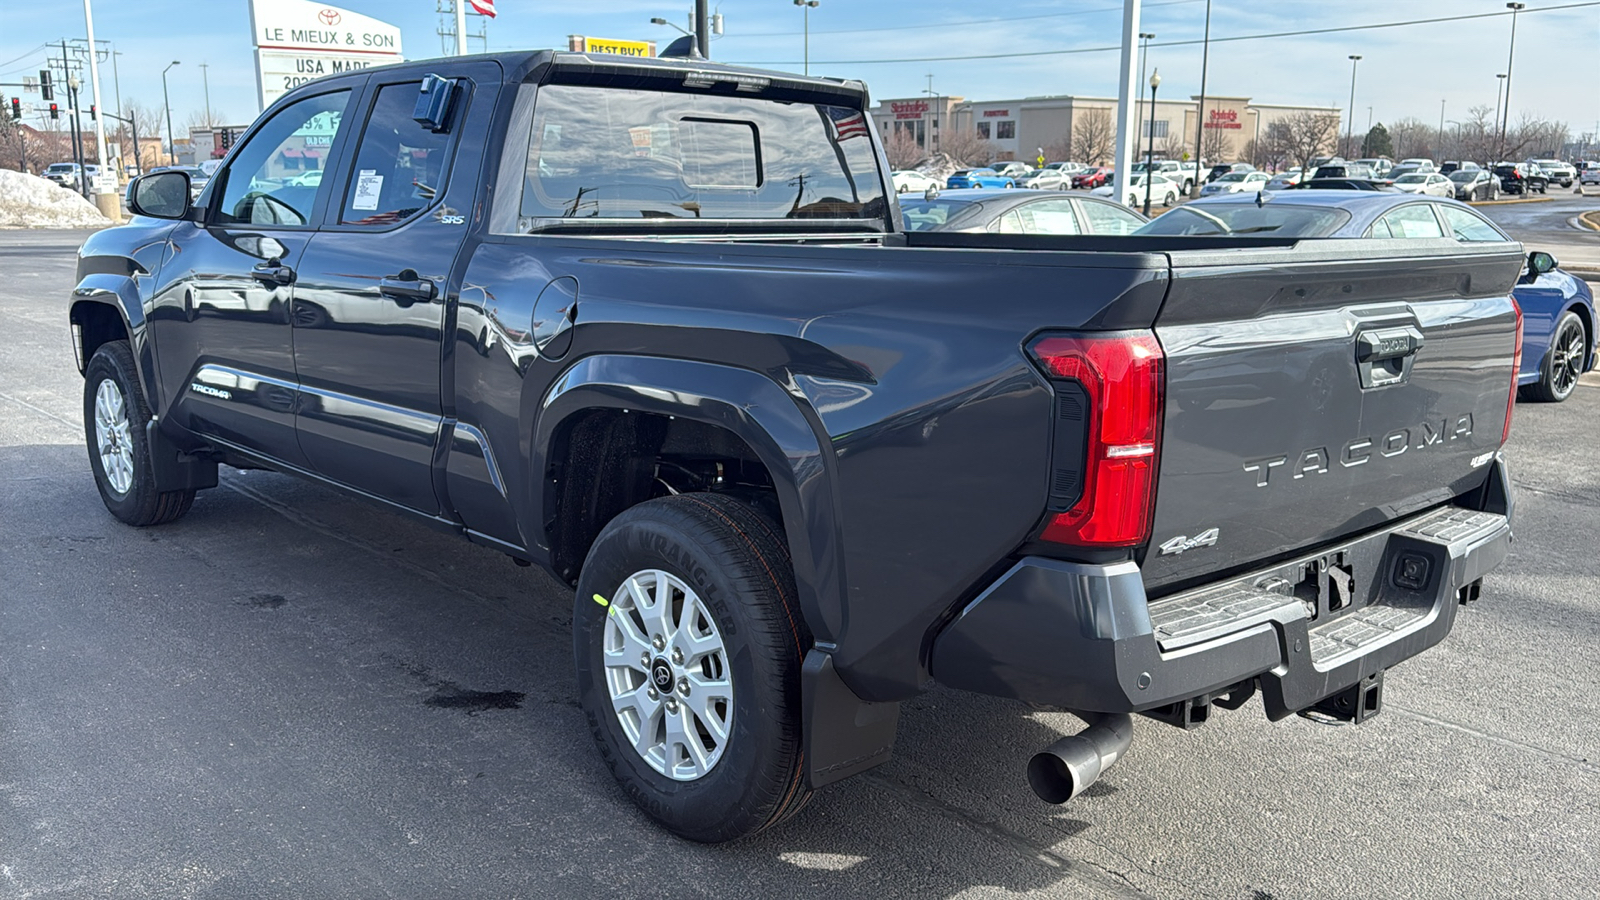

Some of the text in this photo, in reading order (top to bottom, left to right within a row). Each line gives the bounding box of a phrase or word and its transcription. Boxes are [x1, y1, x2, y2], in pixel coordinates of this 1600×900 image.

[265, 27, 394, 48] LE MIEUX & SON
[591, 44, 645, 56] BEST BUY
[296, 58, 325, 74] USA
[191, 383, 230, 399] TACOMA
[1243, 412, 1474, 487] TACOMA
[639, 529, 737, 636] WRANGLER
